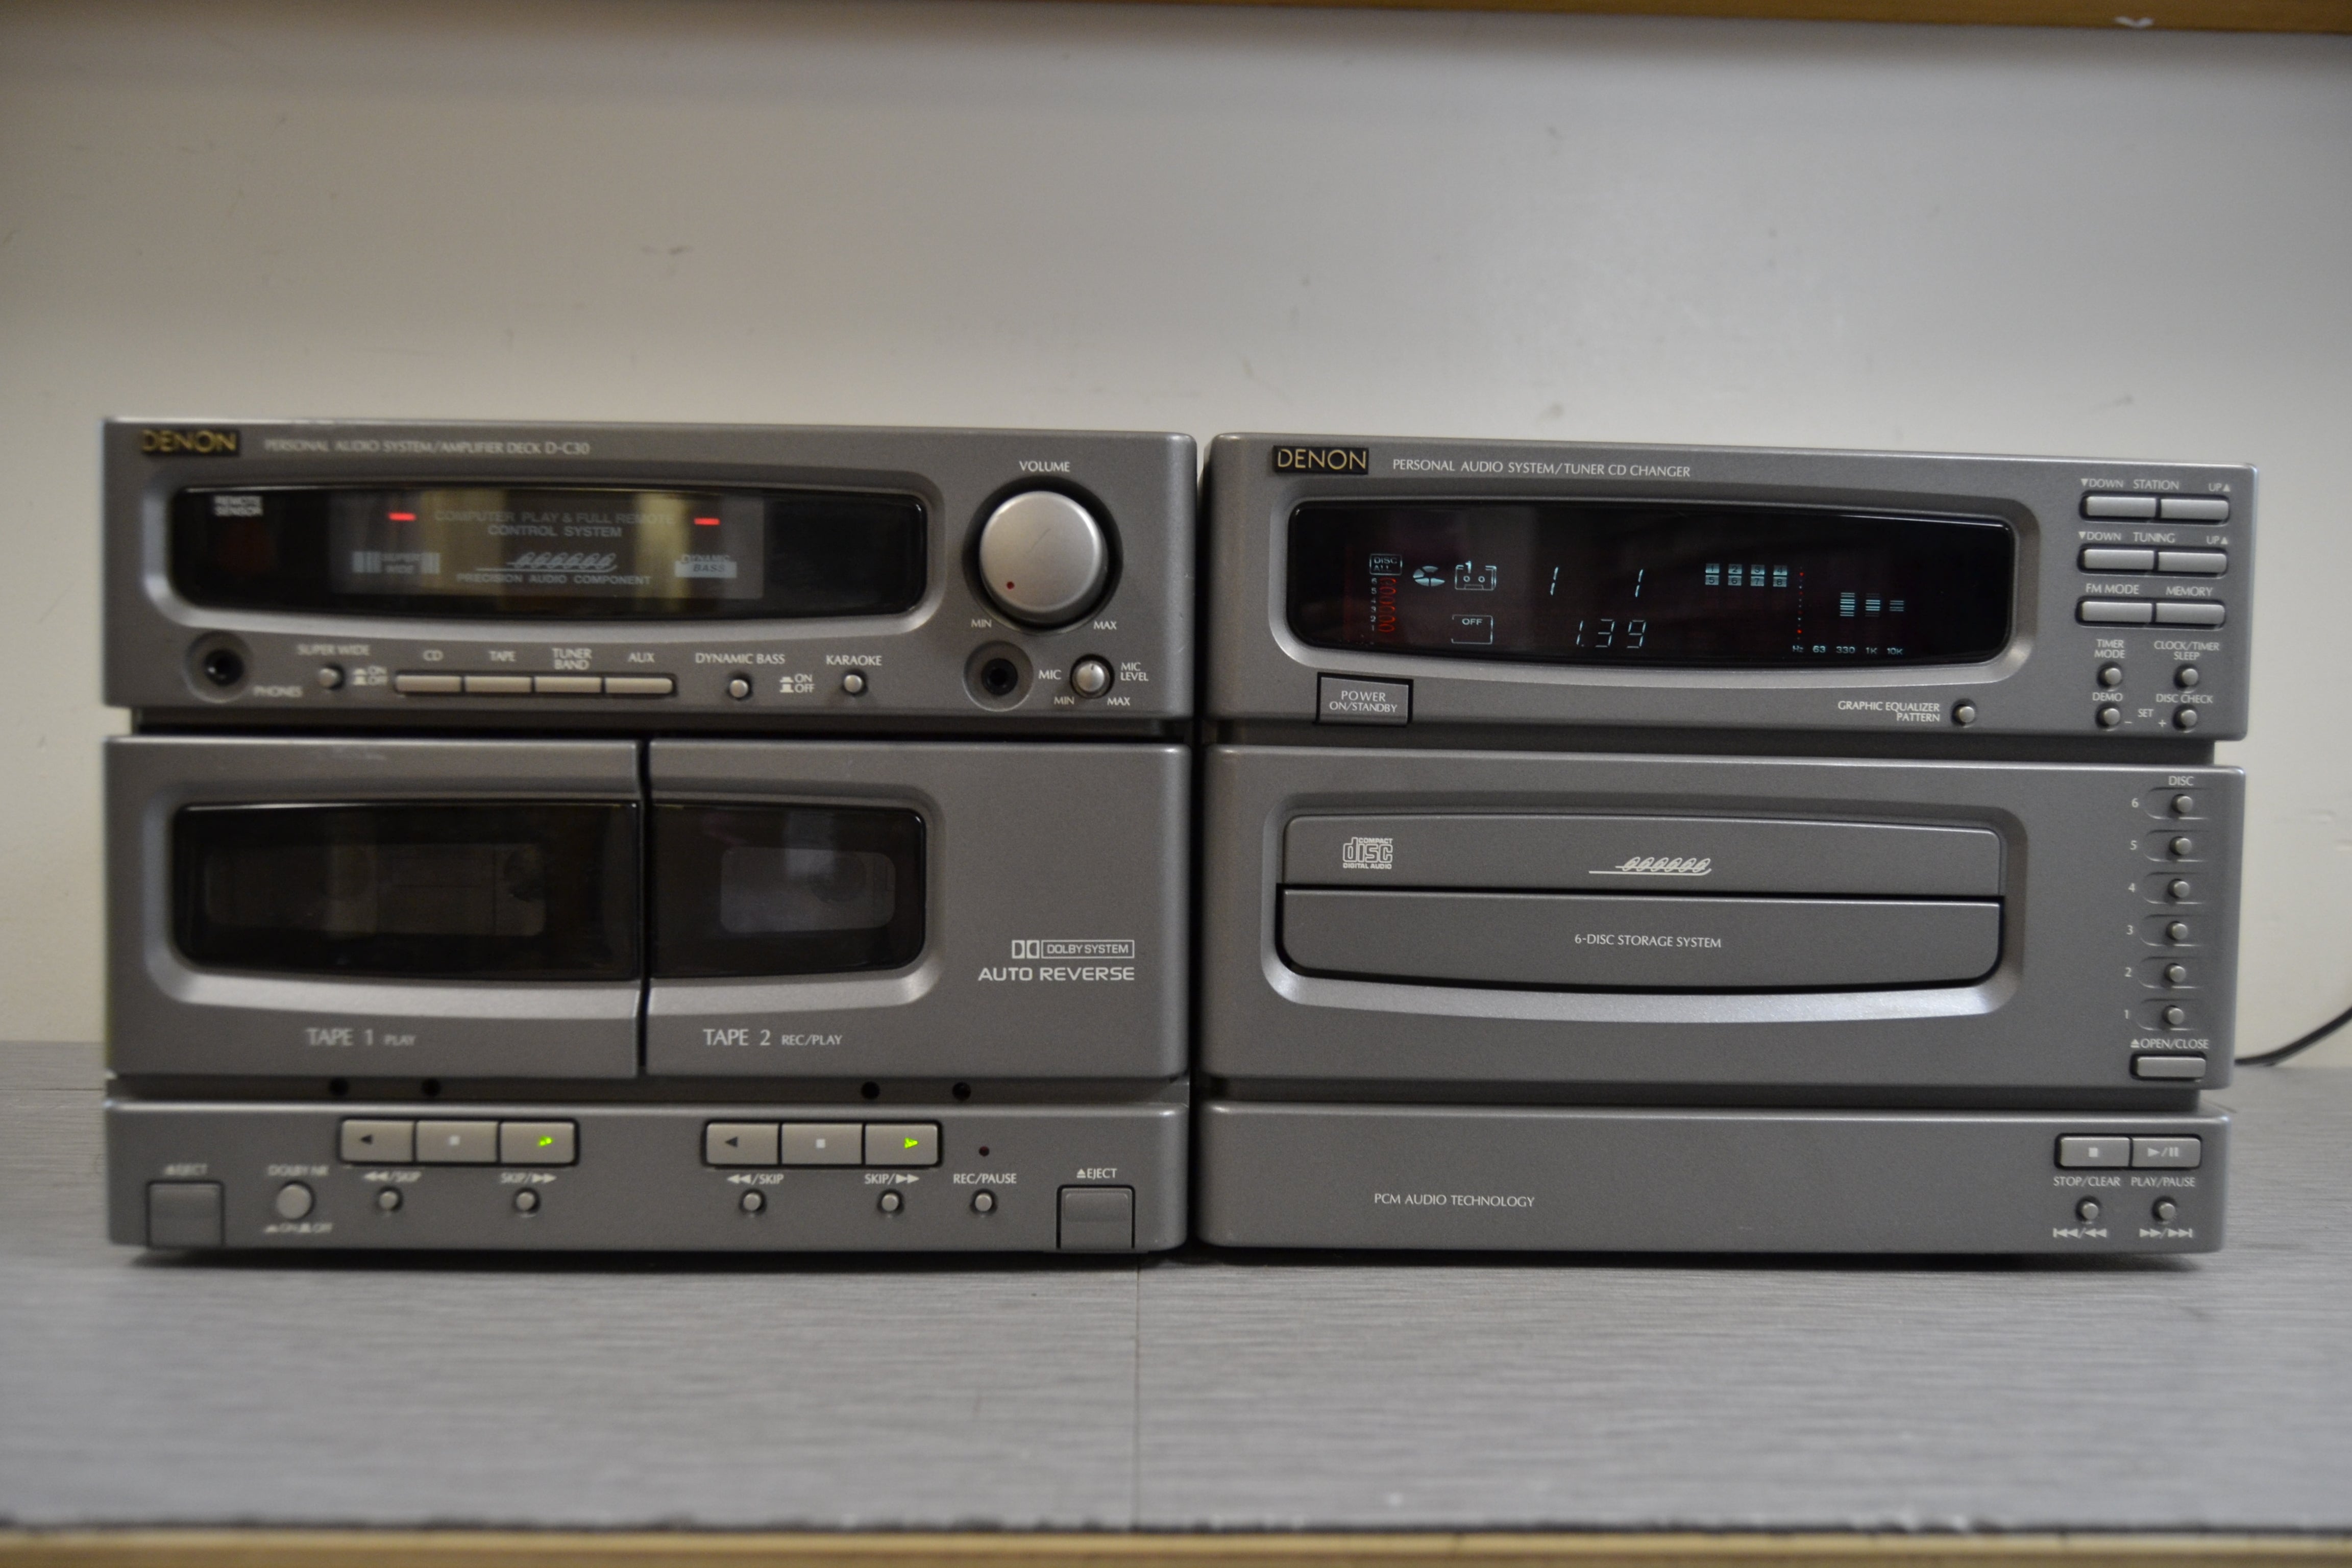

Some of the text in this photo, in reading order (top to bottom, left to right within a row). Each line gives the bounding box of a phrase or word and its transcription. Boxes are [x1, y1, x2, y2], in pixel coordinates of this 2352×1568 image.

[142, 429, 237, 453] DENON
[264, 439, 329, 452] PERSONAL
[334, 439, 380, 452] AUDIO
[507, 440, 542, 454] DECK
[545, 441, 591, 455] D-C30
[1277, 448, 1366, 470] DENON
[1019, 460, 1070, 473] VOLUME
[1393, 459, 1690, 477] PERSONAL AUDIO SYSTEM/TUNER CD CHANGER
[2089, 478, 2222, 492] DOWN STATION UP
[434, 511, 676, 525] COMPUTER PLAY & FULL REMOTE
[487, 525, 623, 537] CONTROL SYSTEM
[2087, 531, 2219, 545] DOWN TUNING UP
[693, 562, 726, 572] BASS
[457, 573, 651, 585] PRECISION AUDIO COMPONENT
[2085, 583, 2140, 594] FM MODE
[2166, 586, 2213, 596] MEMORY
[971, 619, 992, 628] MIN
[1093, 620, 1117, 630] MAX
[1462, 618, 1483, 626] OFF
[2096, 639, 2124, 648] TIMER
[2153, 641, 2220, 651] CLOCK/TIMER
[423, 649, 444, 662] CD
[551, 647, 592, 659] TUNER
[1792, 645, 1804, 653] Hz
[1836, 646, 1856, 654] 330
[1887, 647, 1903, 655] 10K
[2094, 649, 2125, 659] MODE
[2173, 651, 2200, 660] SLEEP
[488, 650, 516, 662] TAPE
[627, 652, 655, 663] AUX
[695, 652, 786, 665] DYNAMIC BASS
[825, 654, 883, 666] KARAOKE
[554, 659, 591, 671] BAND
[1120, 662, 1141, 672] MIC
[794, 673, 813, 683] ON
[1038, 669, 1062, 680] MIC
[1120, 672, 1149, 681] LEVEL
[794, 683, 815, 693] OFF
[1054, 696, 1074, 705] MIN
[1107, 697, 1131, 706] MAX
[1341, 690, 1386, 702] POWER
[2092, 692, 2123, 702] DEMO
[2155, 693, 2213, 704] DISC CHECK
[1329, 701, 1398, 713] ON/STANDBY
[1837, 700, 1940, 713] GRAPHIC EQUALIZER
[1896, 713, 1940, 722] PATTERN
[2138, 708, 2154, 717] SET
[2168, 776, 2194, 786] DISC
[2131, 799, 2139, 808] 6
[1343, 837, 1393, 863] disc
[2130, 841, 2137, 850] 5
[2128, 883, 2136, 893] 4
[2126, 925, 2134, 935] 3
[1574, 933, 1722, 948] 6-DISC STORAGE SYSTEM
[1047, 944, 1129, 954] DOLBY SYSTEM
[977, 967, 1135, 981] AUTO REVERSE
[2125, 968, 2132, 977] 2
[2124, 1010, 2129, 1019] 1
[305, 1027, 416, 1046] TAPE 1 PLAY
[702, 1028, 843, 1046] TAPE 2 REC/PLAY
[2140, 1039, 2210, 1050] OPEN/CLOSE
[952, 1172, 1017, 1185] REC/PAUSE
[1087, 1167, 1118, 1179] EJECT
[2053, 1176, 2196, 1187] STOP/CLEAR PLAY/PAUSE
[1374, 1193, 1535, 1207] PCM AUDIO TECHNOLOGY
